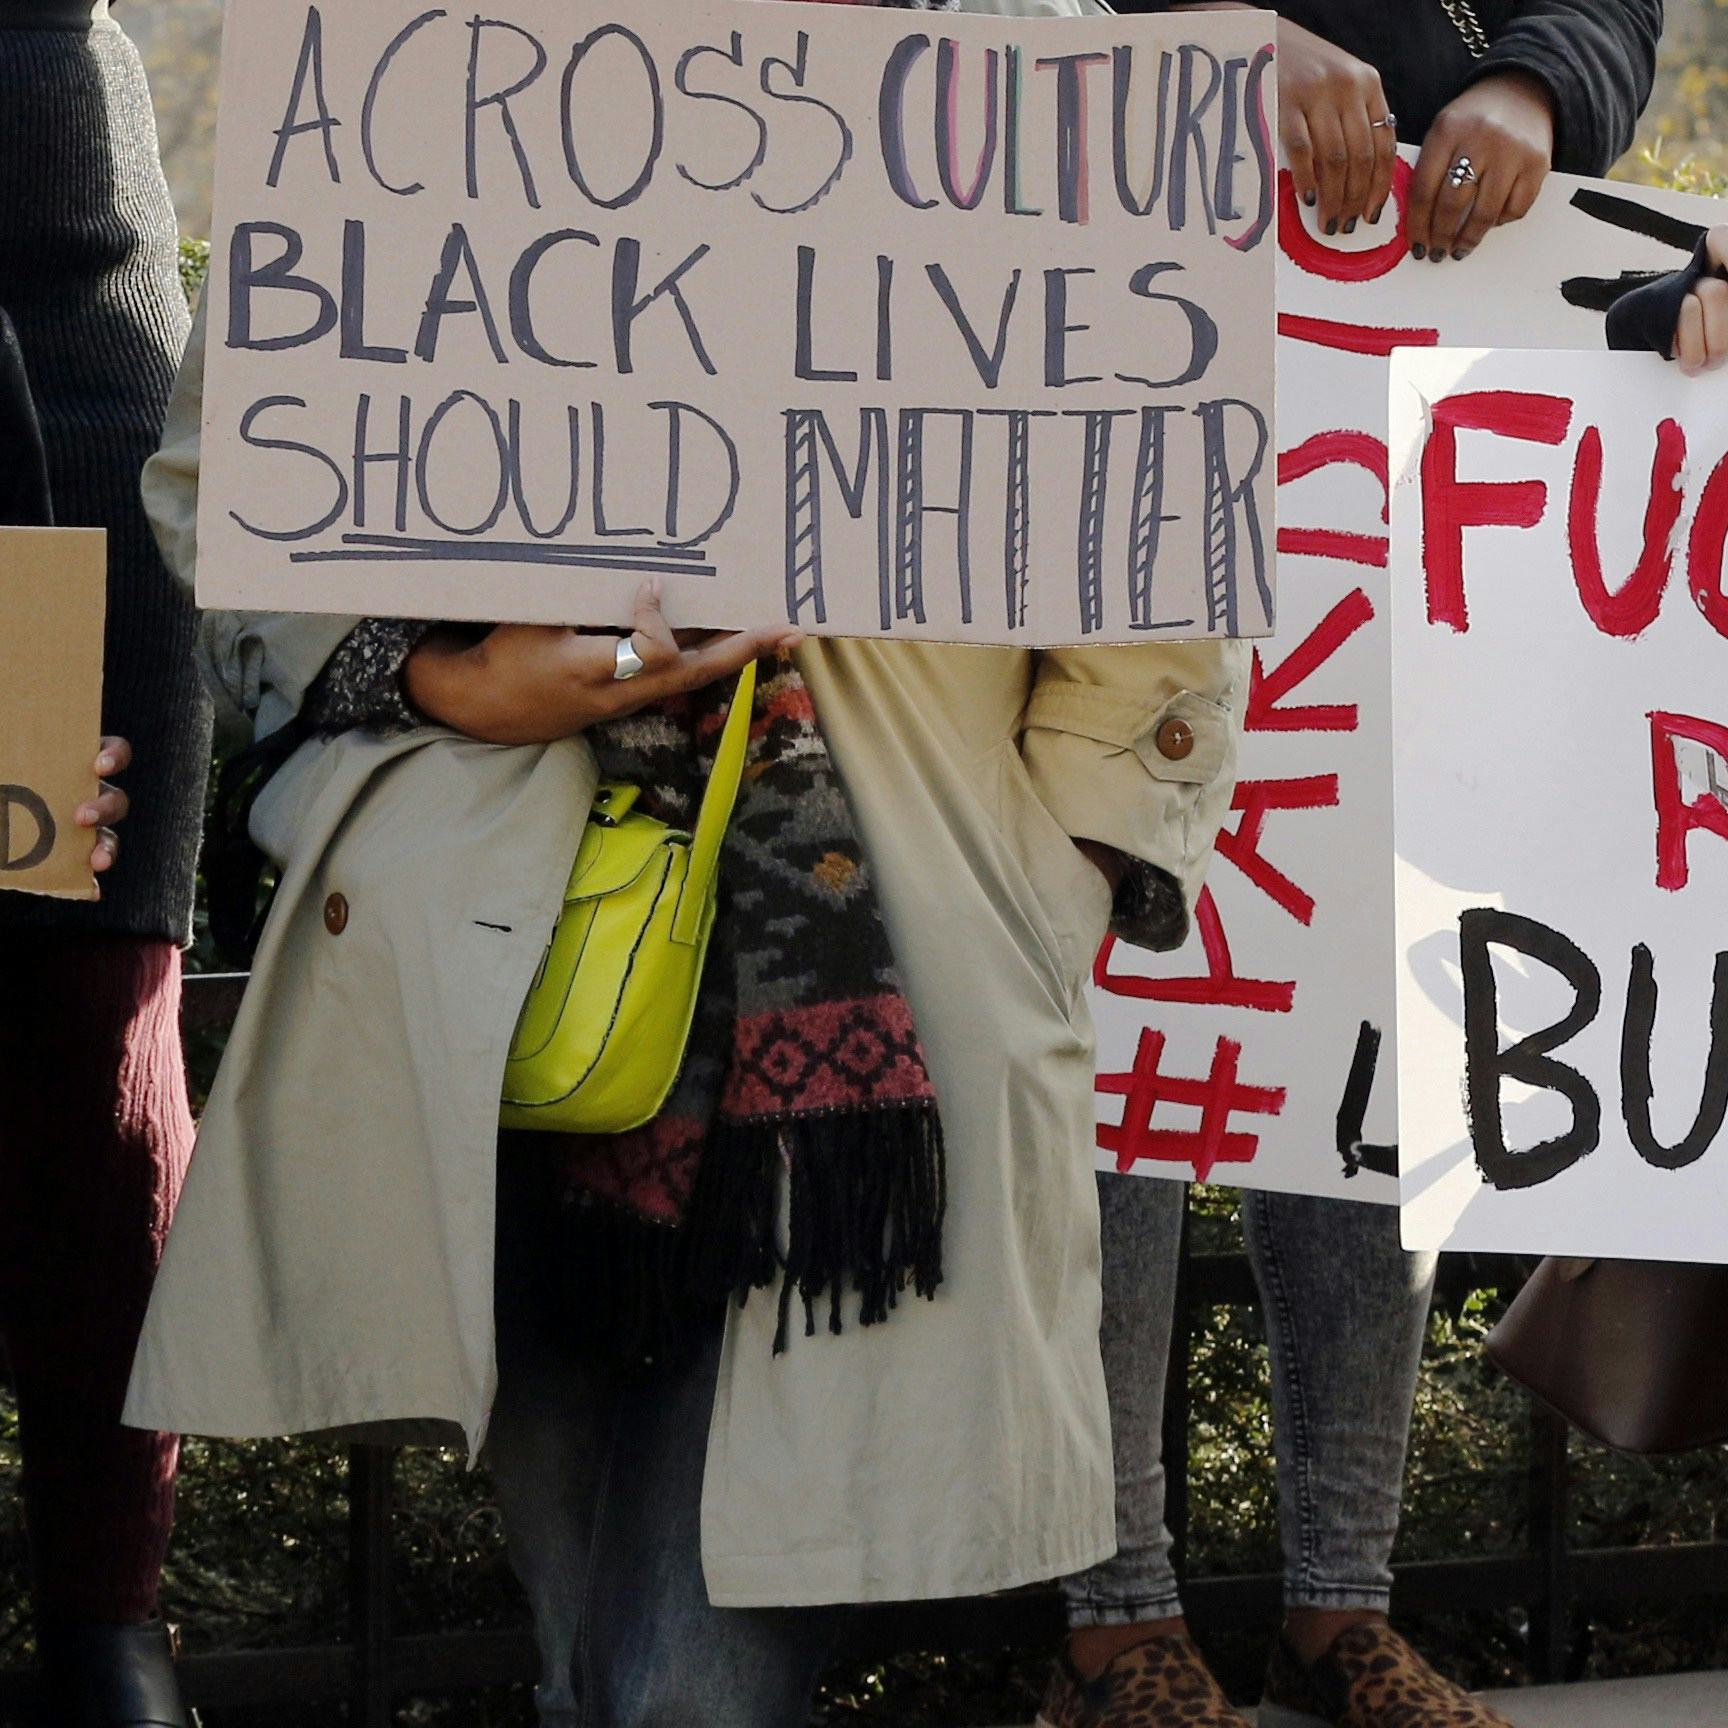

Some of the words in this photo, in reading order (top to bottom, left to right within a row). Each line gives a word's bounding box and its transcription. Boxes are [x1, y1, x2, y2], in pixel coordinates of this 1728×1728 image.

[266, 3, 853, 216] ACROSS
[877, 32, 1276, 254] CULTURES
[224, 219, 717, 377] BLACK
[794, 244, 1219, 390] LIVES
[228, 388, 741, 549] SHOULD
[781, 397, 1273, 634] MATTER
